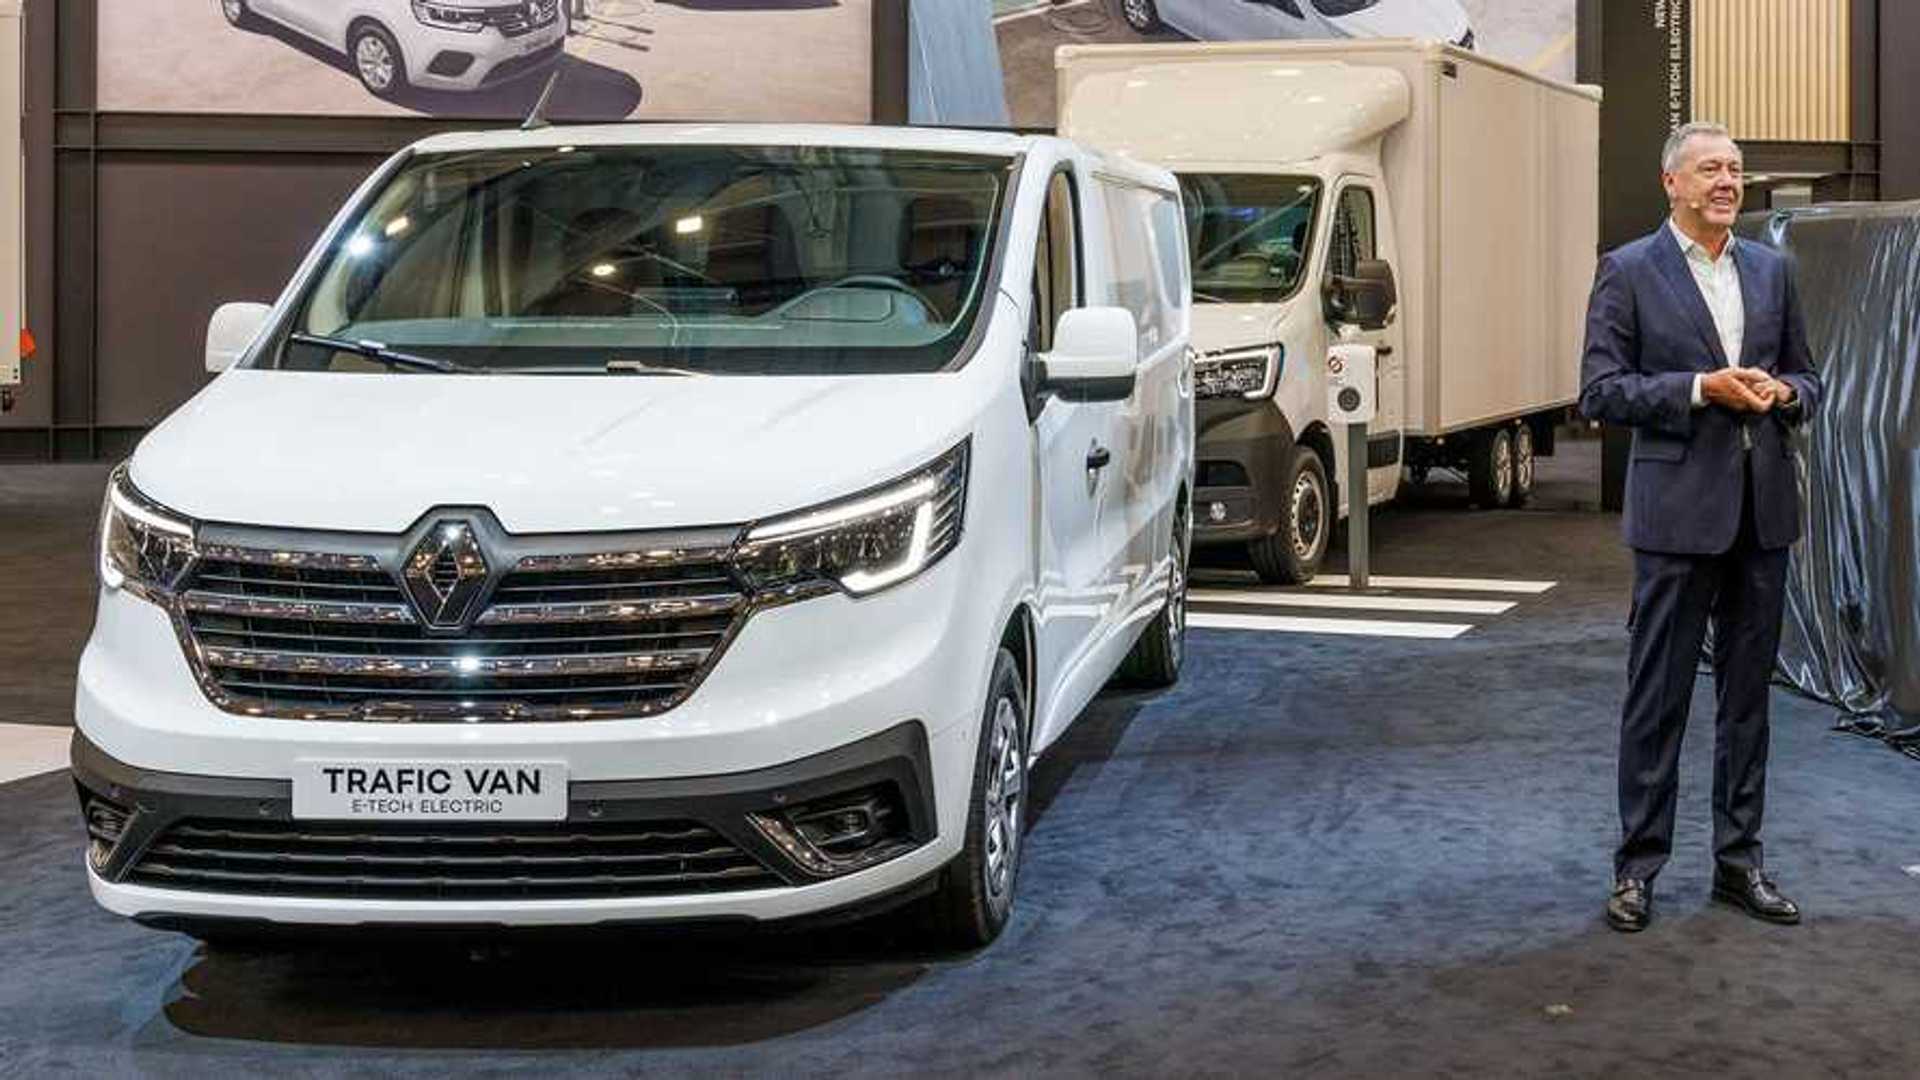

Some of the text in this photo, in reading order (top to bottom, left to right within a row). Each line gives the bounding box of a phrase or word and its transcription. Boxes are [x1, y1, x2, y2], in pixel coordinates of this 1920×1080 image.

[1655, 0, 1665, 28] NEW
[1669, 62, 1681, 110] E-TECH
[322, 768, 541, 795] TRAFIC VAN
[351, 799, 503, 814] E-TECH ELECTRIC
